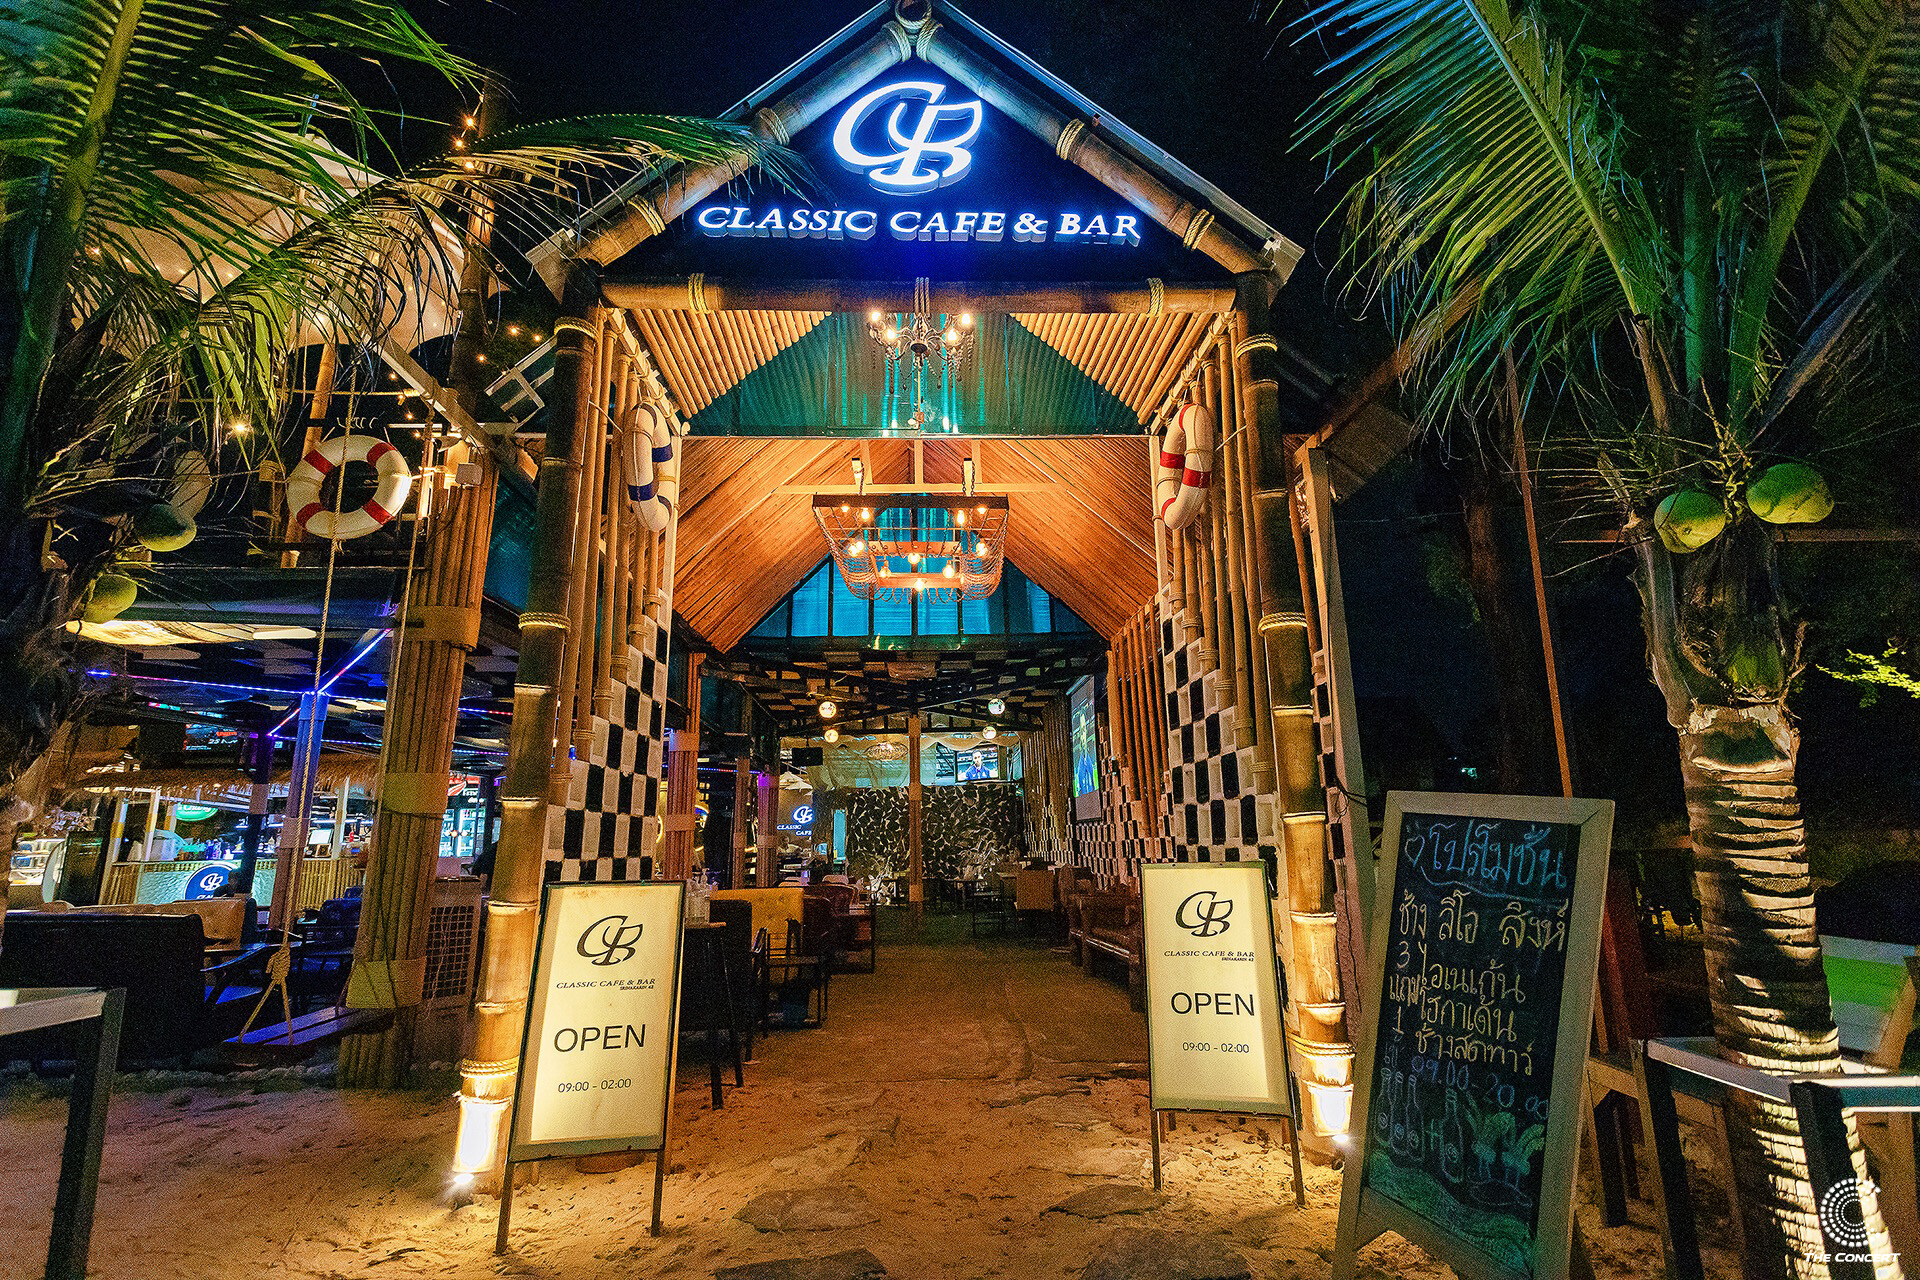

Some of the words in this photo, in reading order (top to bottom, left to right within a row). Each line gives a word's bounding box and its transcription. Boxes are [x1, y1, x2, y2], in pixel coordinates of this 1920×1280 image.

[698, 206, 877, 236] CLASSIC
[890, 210, 1005, 238] CAFE
[1013, 212, 1048, 240] &
[1055, 213, 1141, 241] BAR
[1398, 889, 1428, 940] ช้าง
[1236, 950, 1255, 958] BAR
[1396, 940, 1411, 969] 3
[556, 981, 598, 989] CLASSIC
[599, 979, 625, 987] CAFE
[1389, 973, 1421, 1007] แถม
[1170, 991, 1255, 1016] OPEN
[1391, 1006, 1404, 1035] 1
[553, 1023, 646, 1052] OPEN
[1182, 1041, 1211, 1052] 09:00
[1220, 1043, 1250, 1054] 02:00
[557, 1081, 589, 1093] 09:00
[600, 1078, 632, 1090] 02:00
